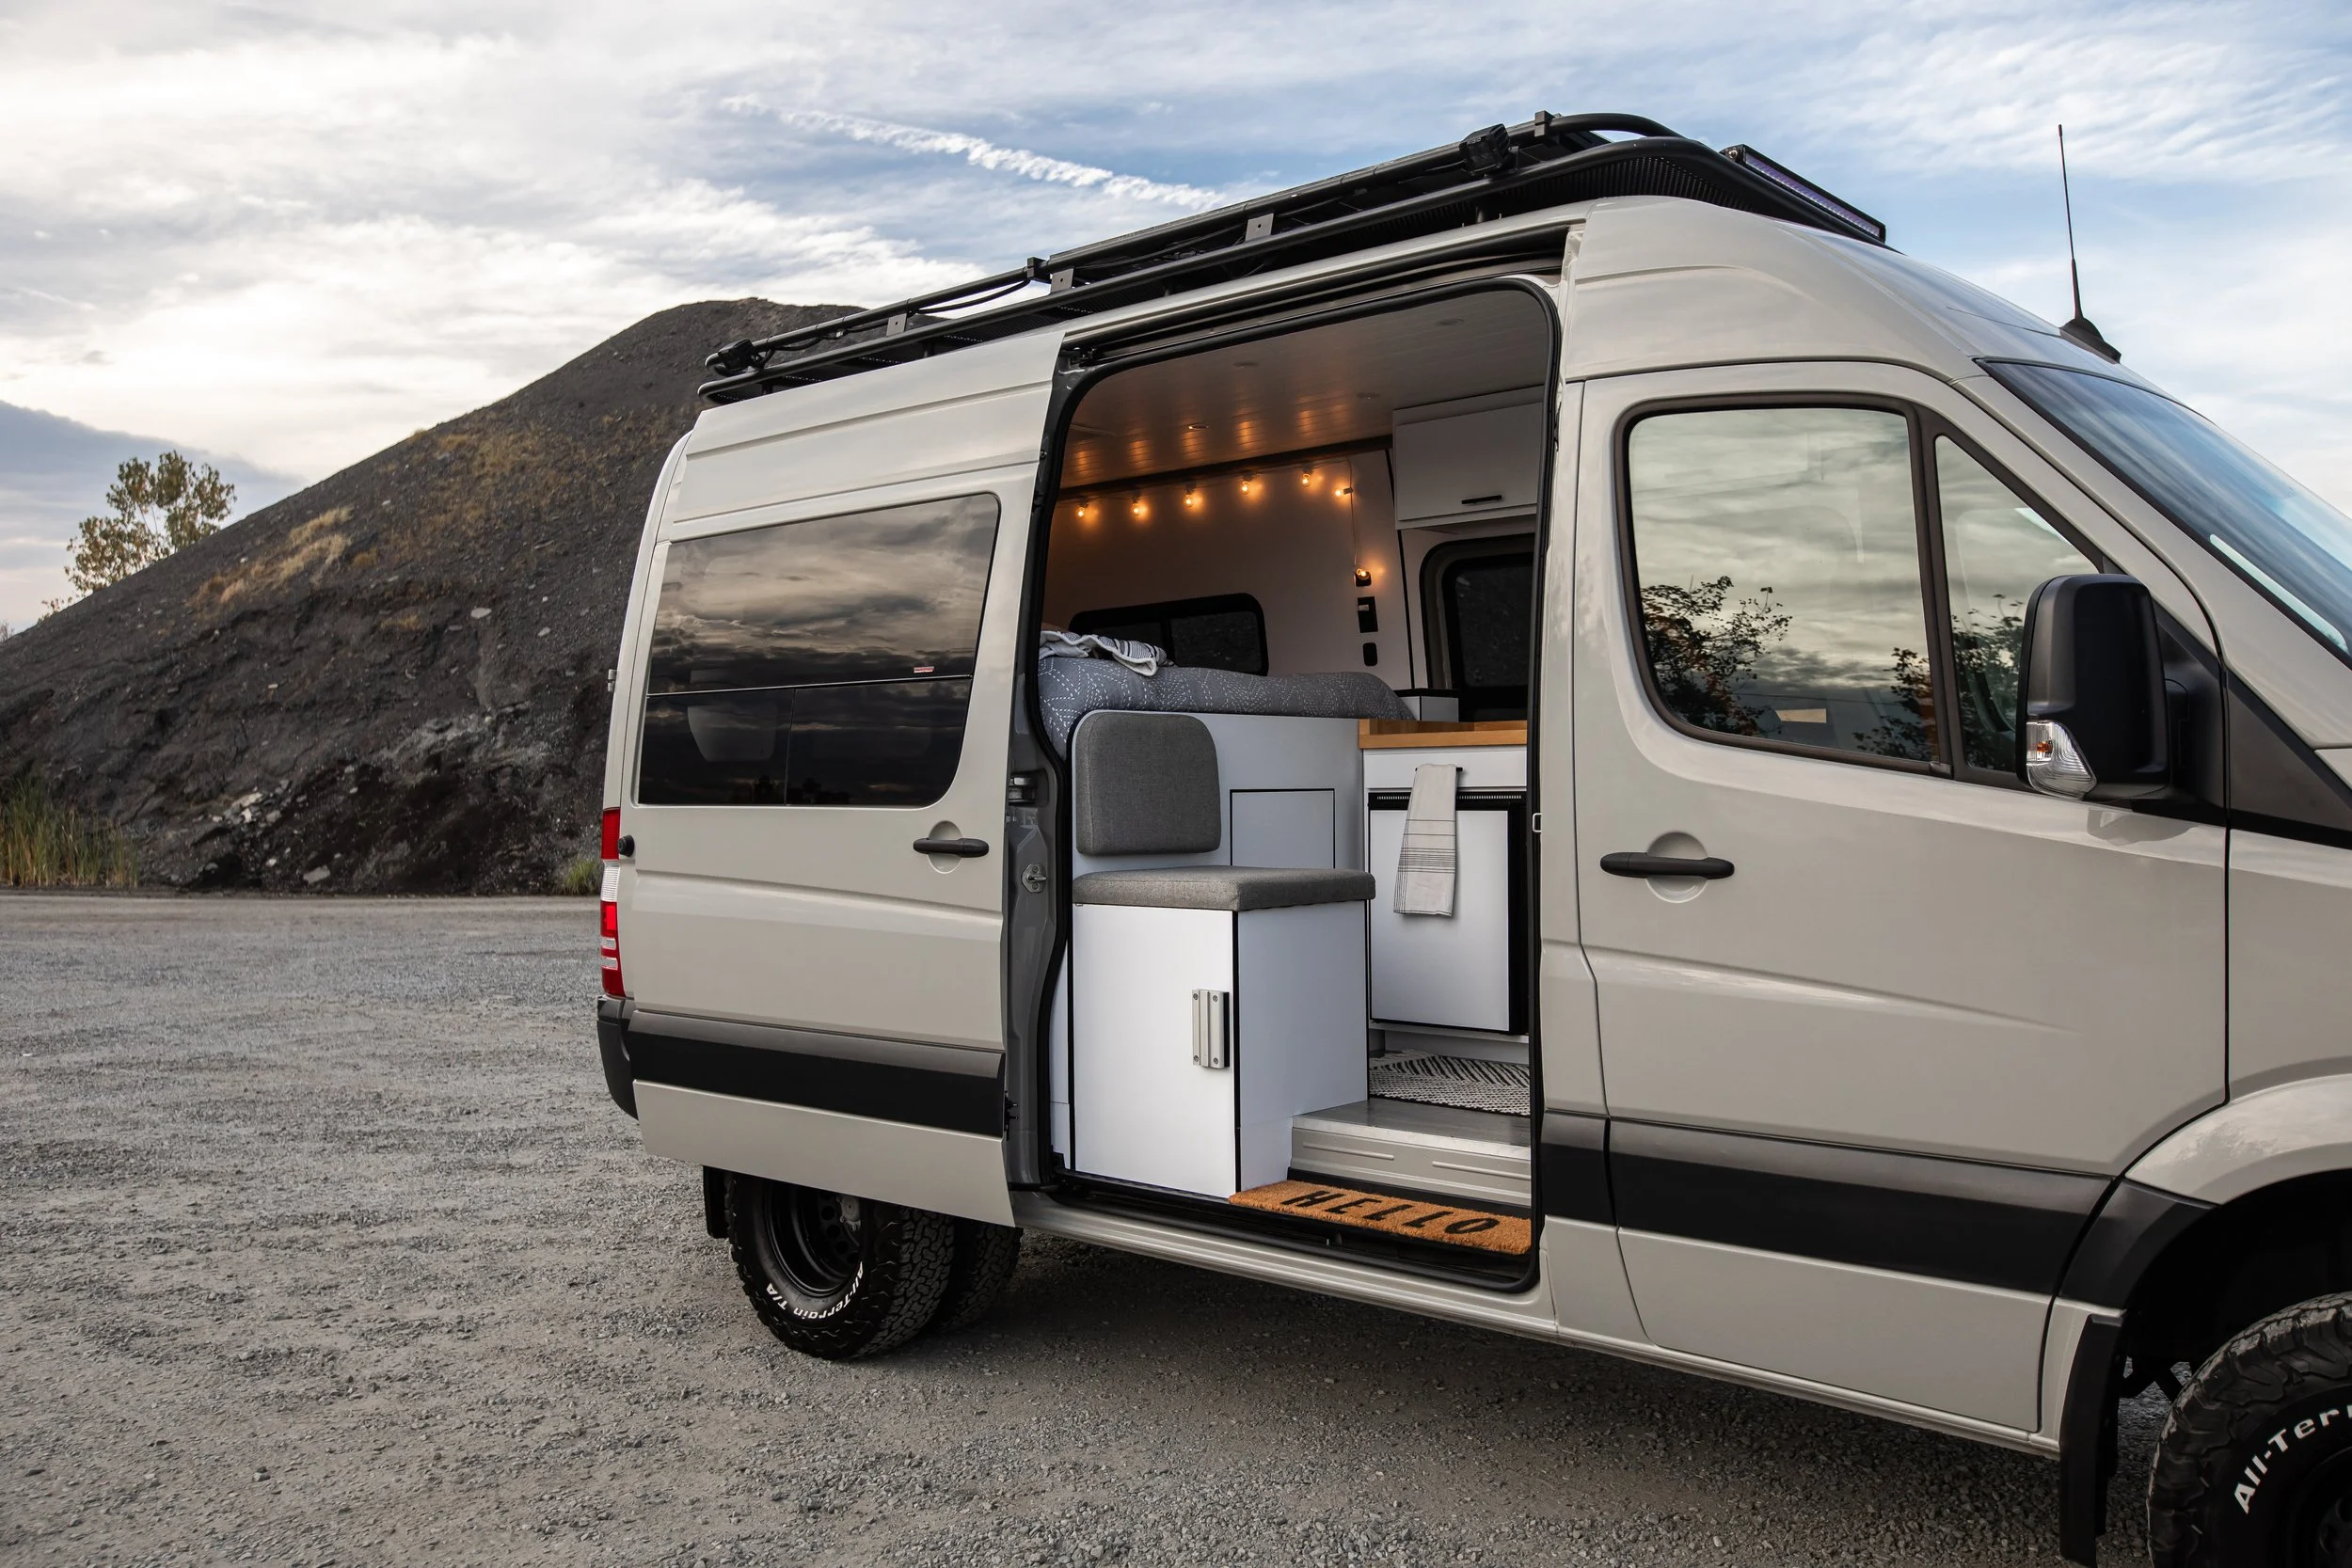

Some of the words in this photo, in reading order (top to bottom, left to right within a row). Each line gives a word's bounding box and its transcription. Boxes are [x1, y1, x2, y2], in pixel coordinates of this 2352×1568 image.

[1279, 1190, 1501, 1234] HELLO
[766, 1283, 787, 1310] T/A
[793, 1261, 864, 1320] All-Terrain
